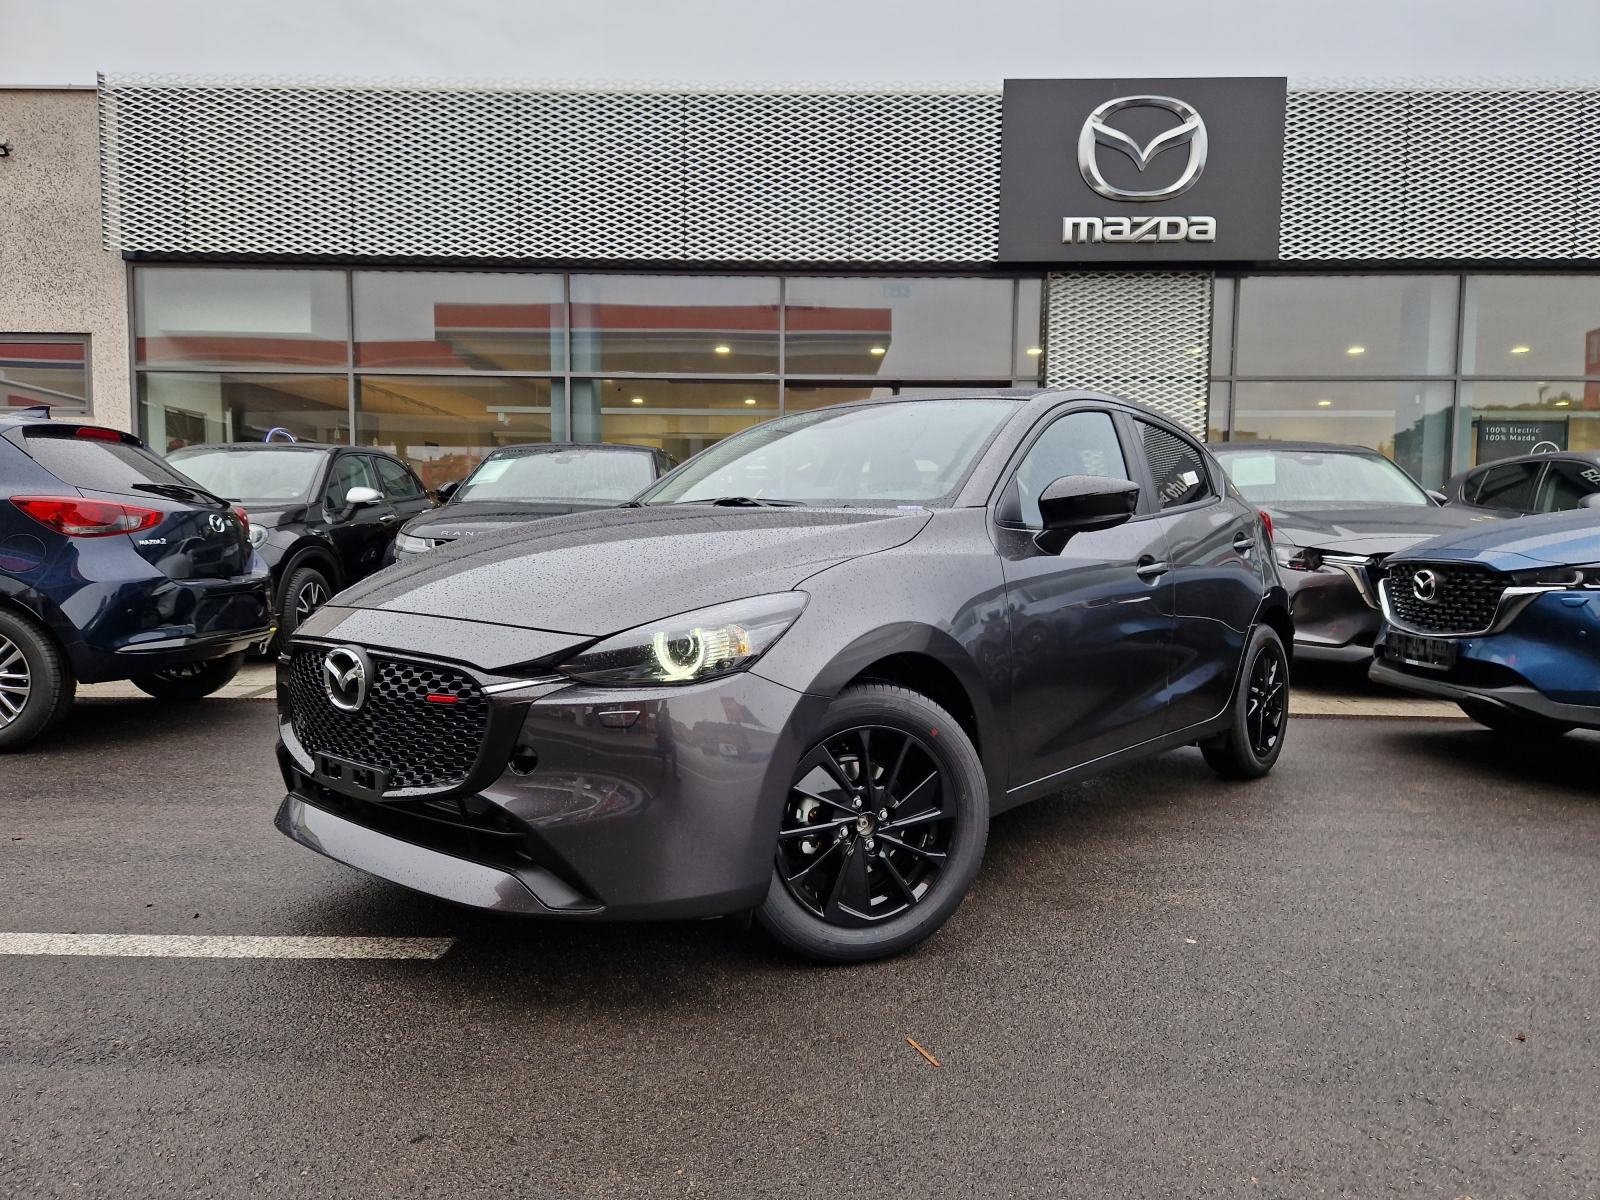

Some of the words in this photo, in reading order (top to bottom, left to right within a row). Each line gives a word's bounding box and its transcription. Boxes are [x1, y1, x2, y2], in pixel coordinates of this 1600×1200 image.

[1062, 216, 1217, 244] mazda
[1486, 426, 1507, 434] 100%
[1510, 426, 1541, 434] Electric
